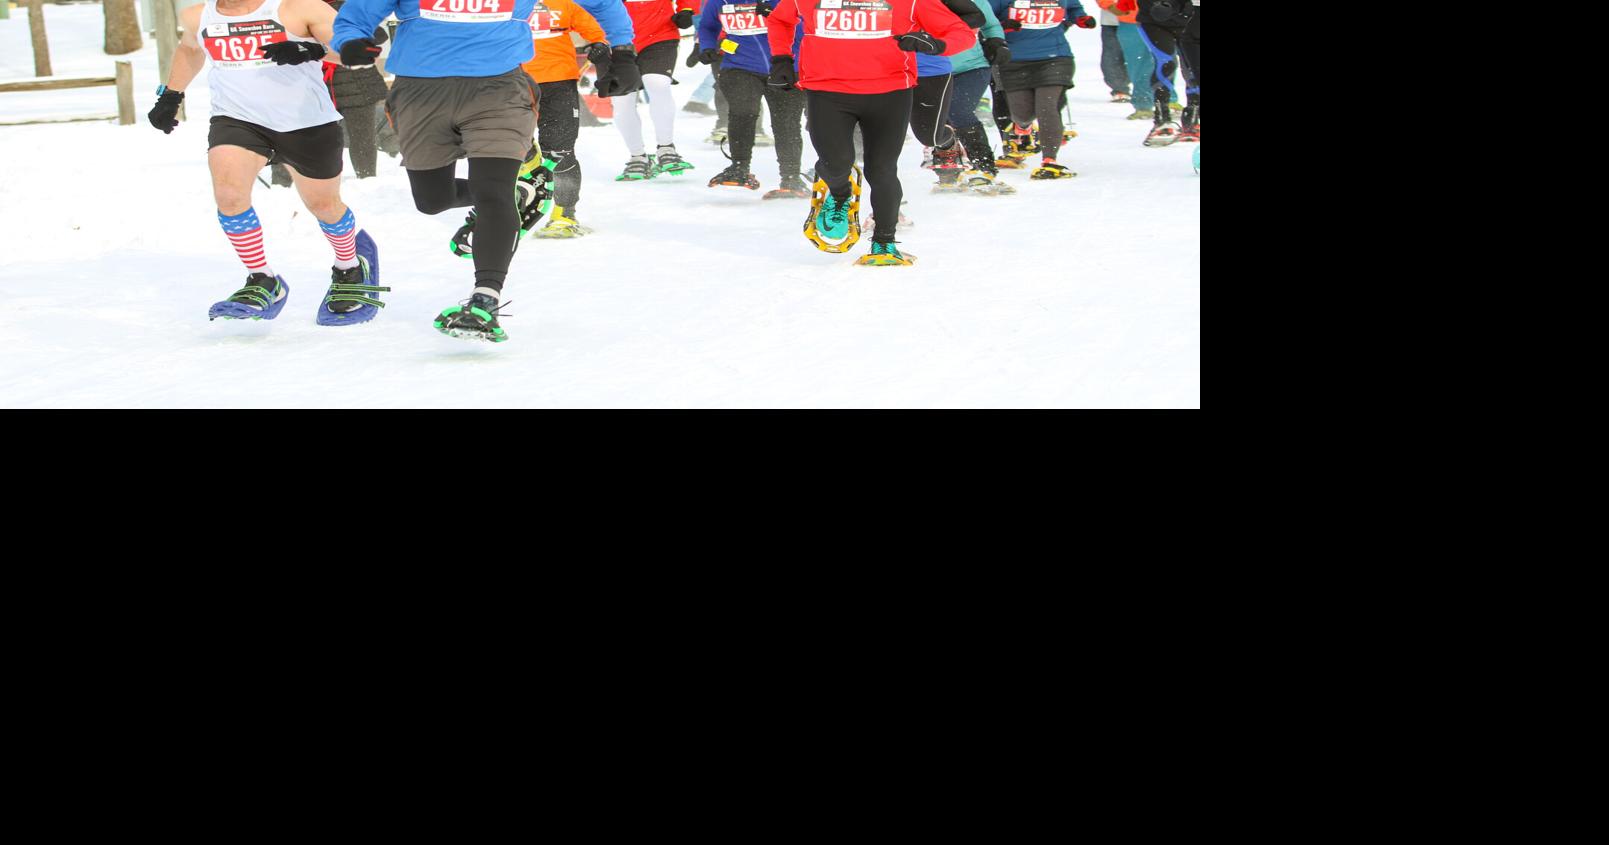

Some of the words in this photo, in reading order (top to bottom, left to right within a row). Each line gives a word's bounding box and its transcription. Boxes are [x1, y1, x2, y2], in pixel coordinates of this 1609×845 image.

[727, 13, 765, 30] 2621
[825, 10, 877, 31] 2601
[1018, 9, 1055, 24] 2612
